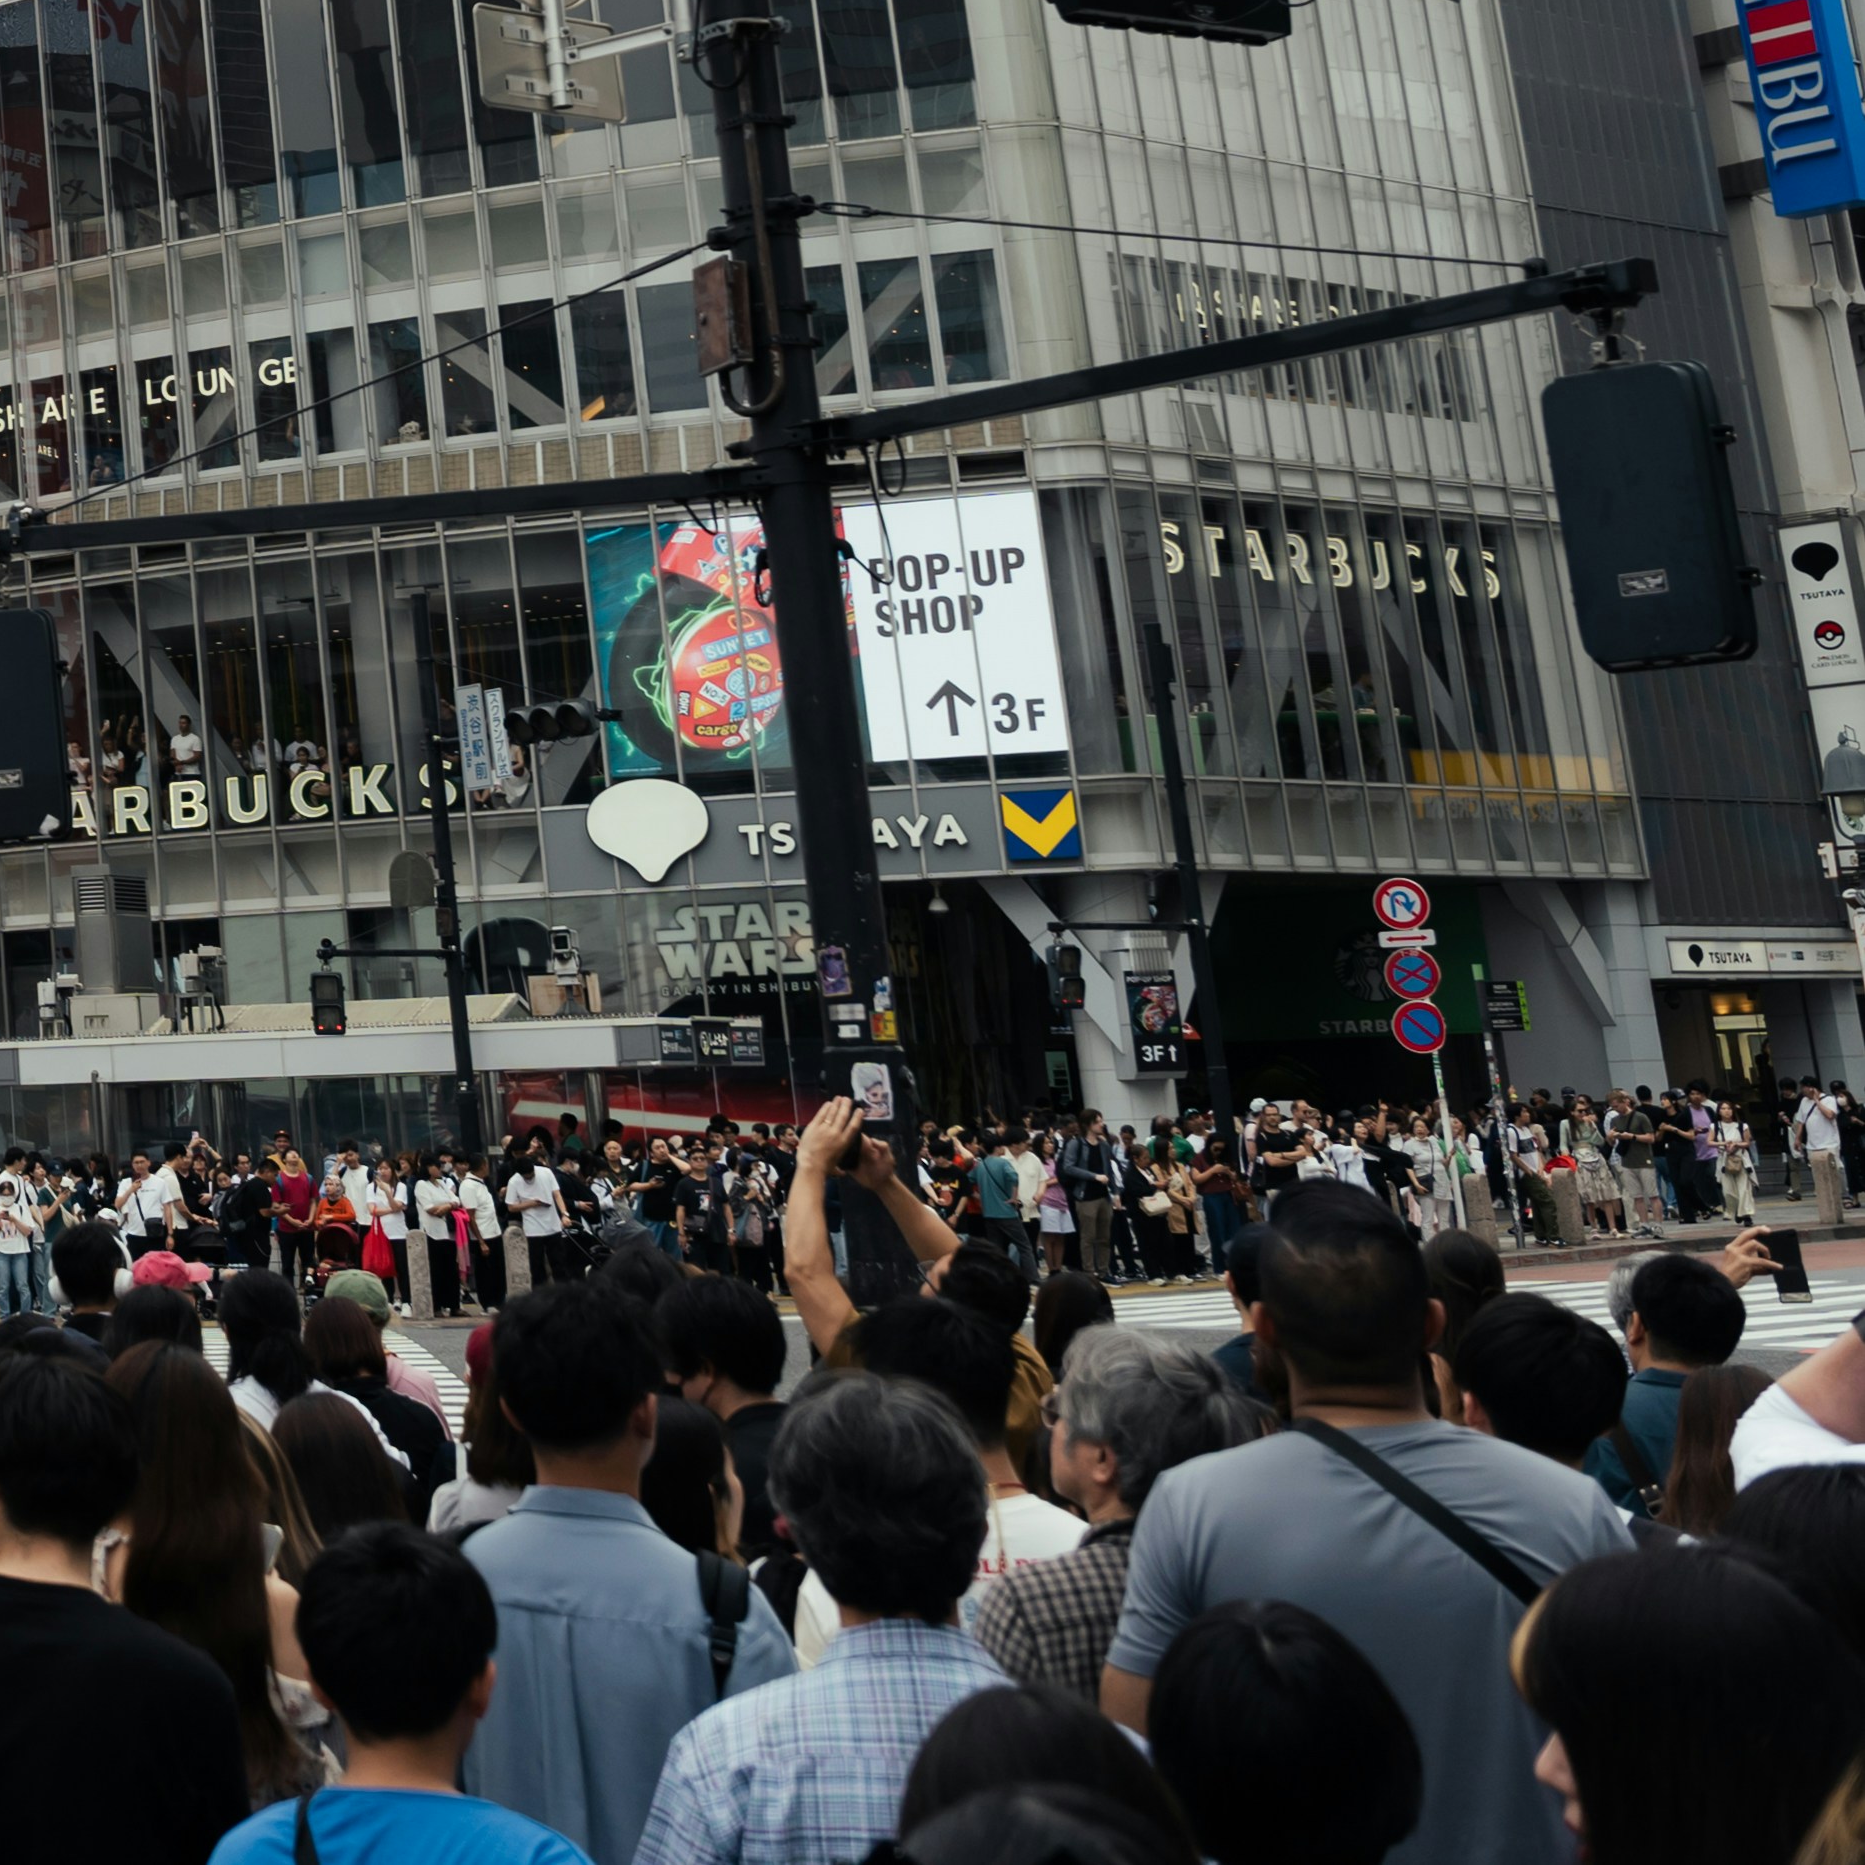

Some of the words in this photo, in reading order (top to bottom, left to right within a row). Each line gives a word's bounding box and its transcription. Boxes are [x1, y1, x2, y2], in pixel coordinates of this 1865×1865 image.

[868, 546, 1027, 594] POP-UP
[1160, 521, 1502, 600] STARBUCKS
[874, 593, 985, 637] SHOP
[1799, 587, 1847, 601] TSUTAYA
[696, 723, 739, 737] cargo
[991, 693, 1046, 734] 3F
[70, 761, 459, 838] ARBUCKS
[738, 813, 969, 856] TSAYA
[656, 899, 815, 944] STAR
[657, 936, 819, 979] WARS
[1708, 950, 1753, 964] TSUTAYA
[660, 983, 728, 998] GALAXY
[733, 982, 754, 995] IN
[1152, 974, 1173, 983] SHOP
[1141, 1044, 1165, 1063] 3F
